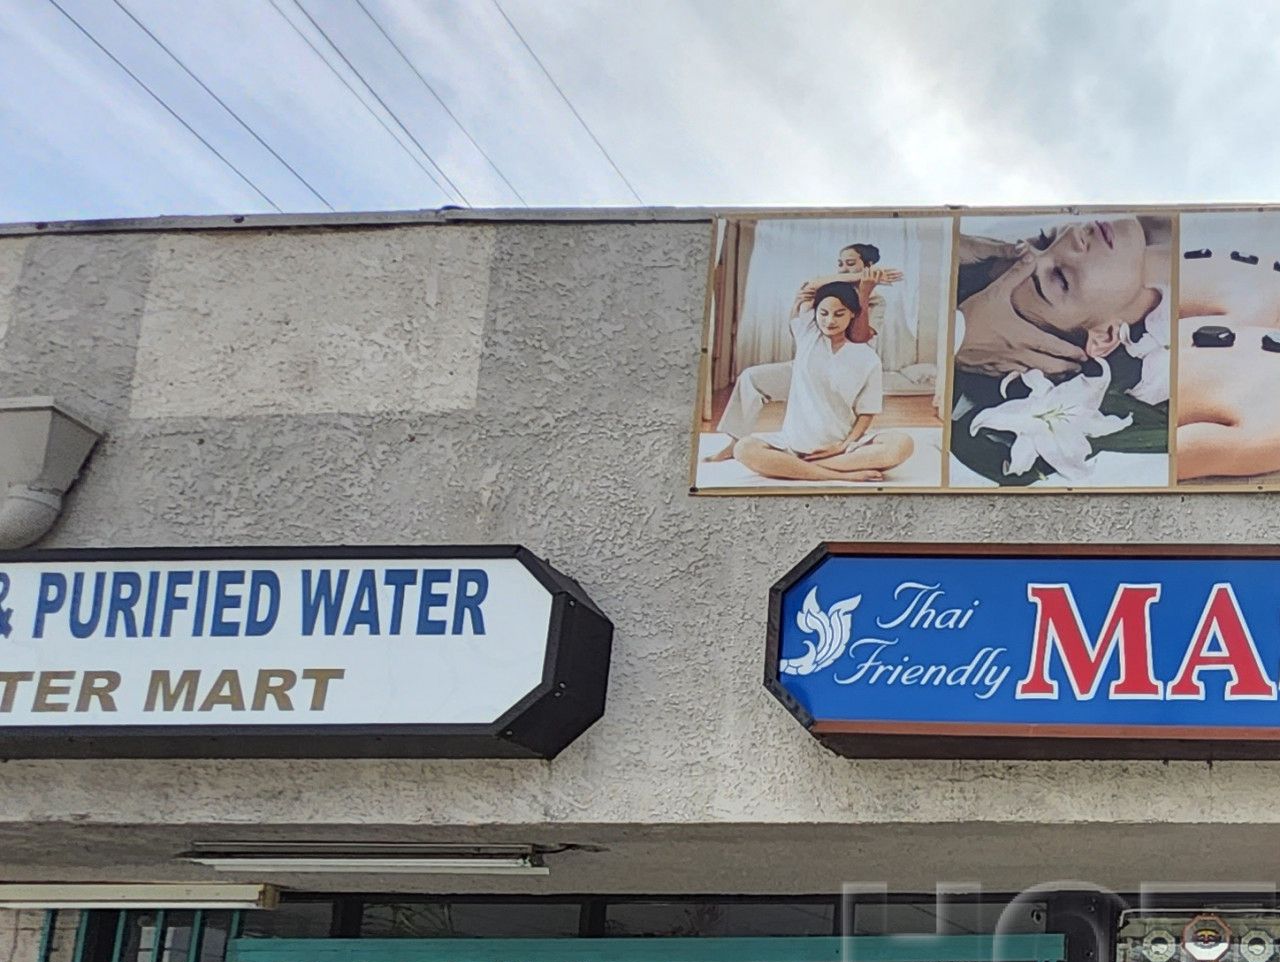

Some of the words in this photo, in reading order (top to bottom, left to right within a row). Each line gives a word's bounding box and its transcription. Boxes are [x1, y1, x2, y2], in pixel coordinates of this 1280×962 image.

[32, 569, 281, 639] PURIFIED
[301, 568, 489, 636] WATER
[877, 581, 980, 630] Thai
[143, 668, 346, 712] MART
[834, 637, 1011, 700] Friendly
